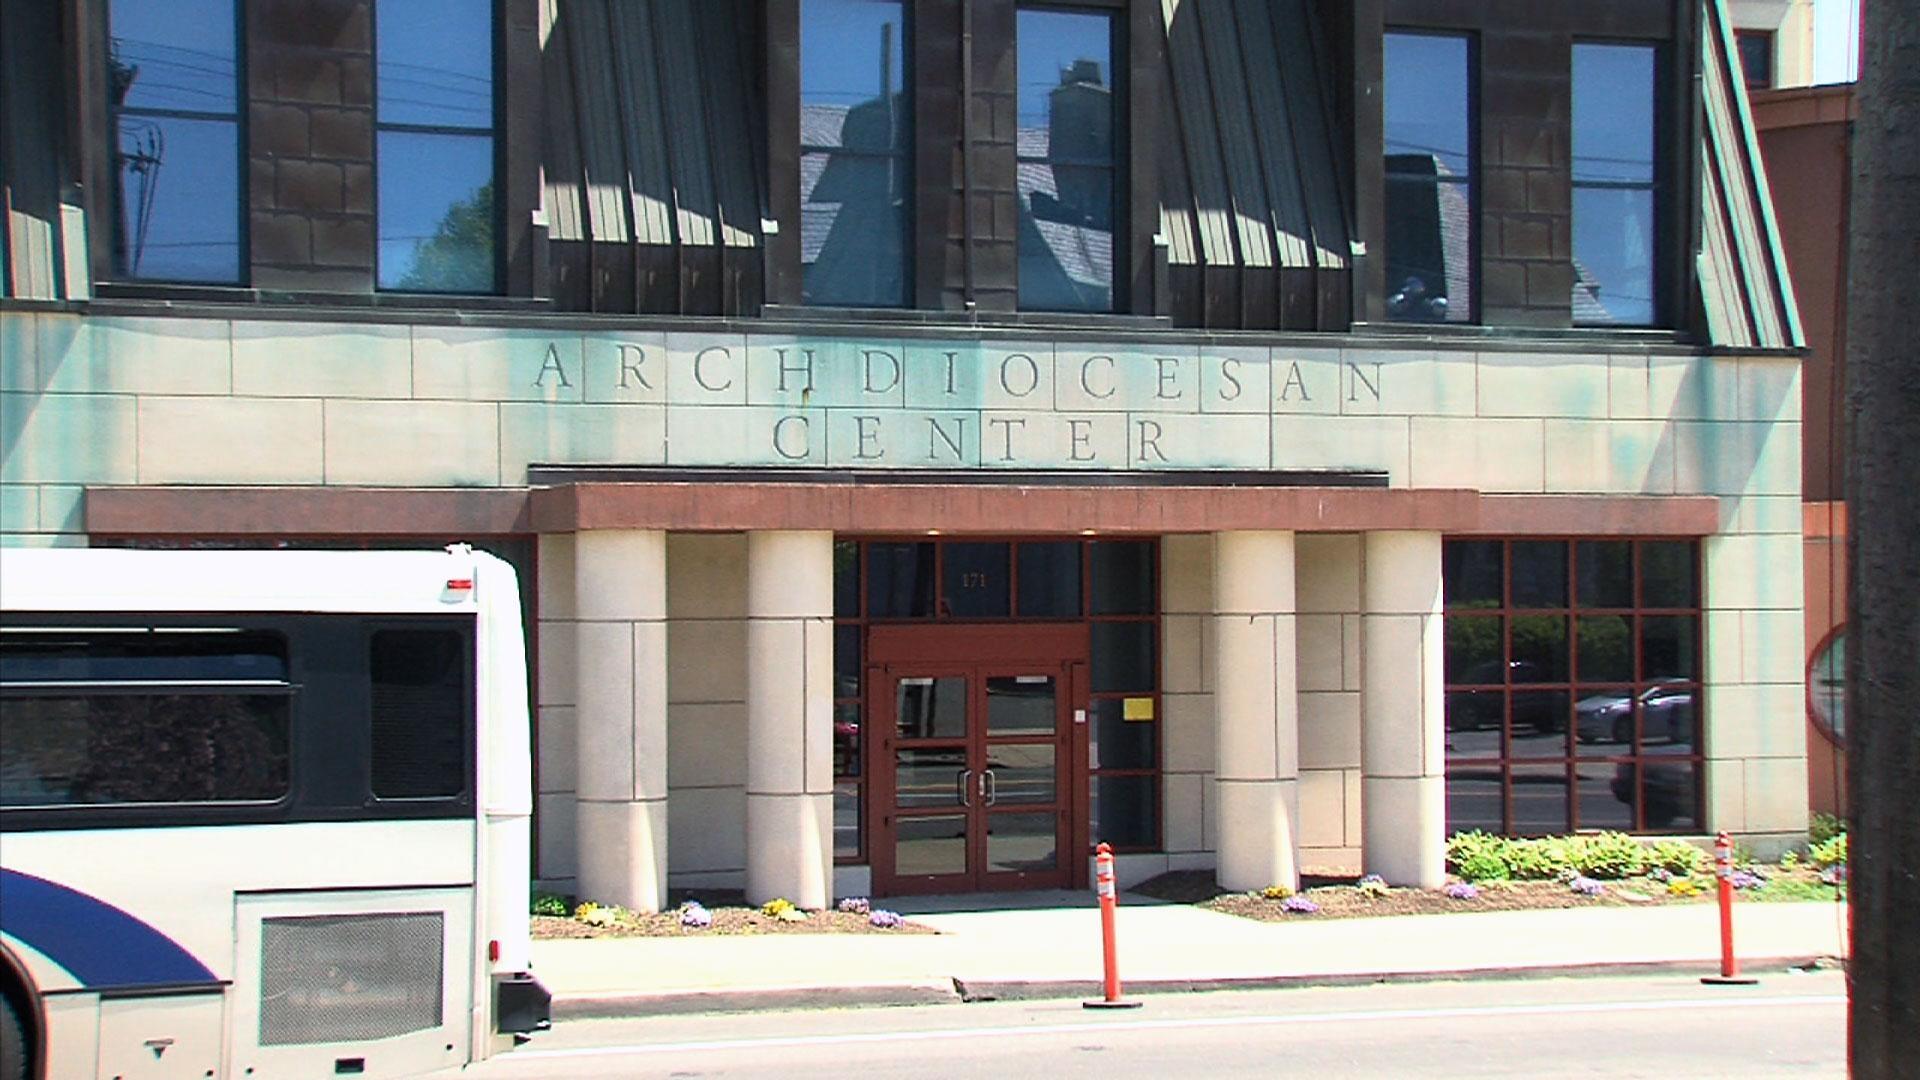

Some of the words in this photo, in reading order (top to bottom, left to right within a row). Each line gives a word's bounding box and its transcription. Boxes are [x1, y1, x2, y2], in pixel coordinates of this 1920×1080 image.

[533, 341, 1385, 402] ARCHDIOCESAN
[773, 415, 1168, 462] CENTER
[962, 573, 986, 588] 171
